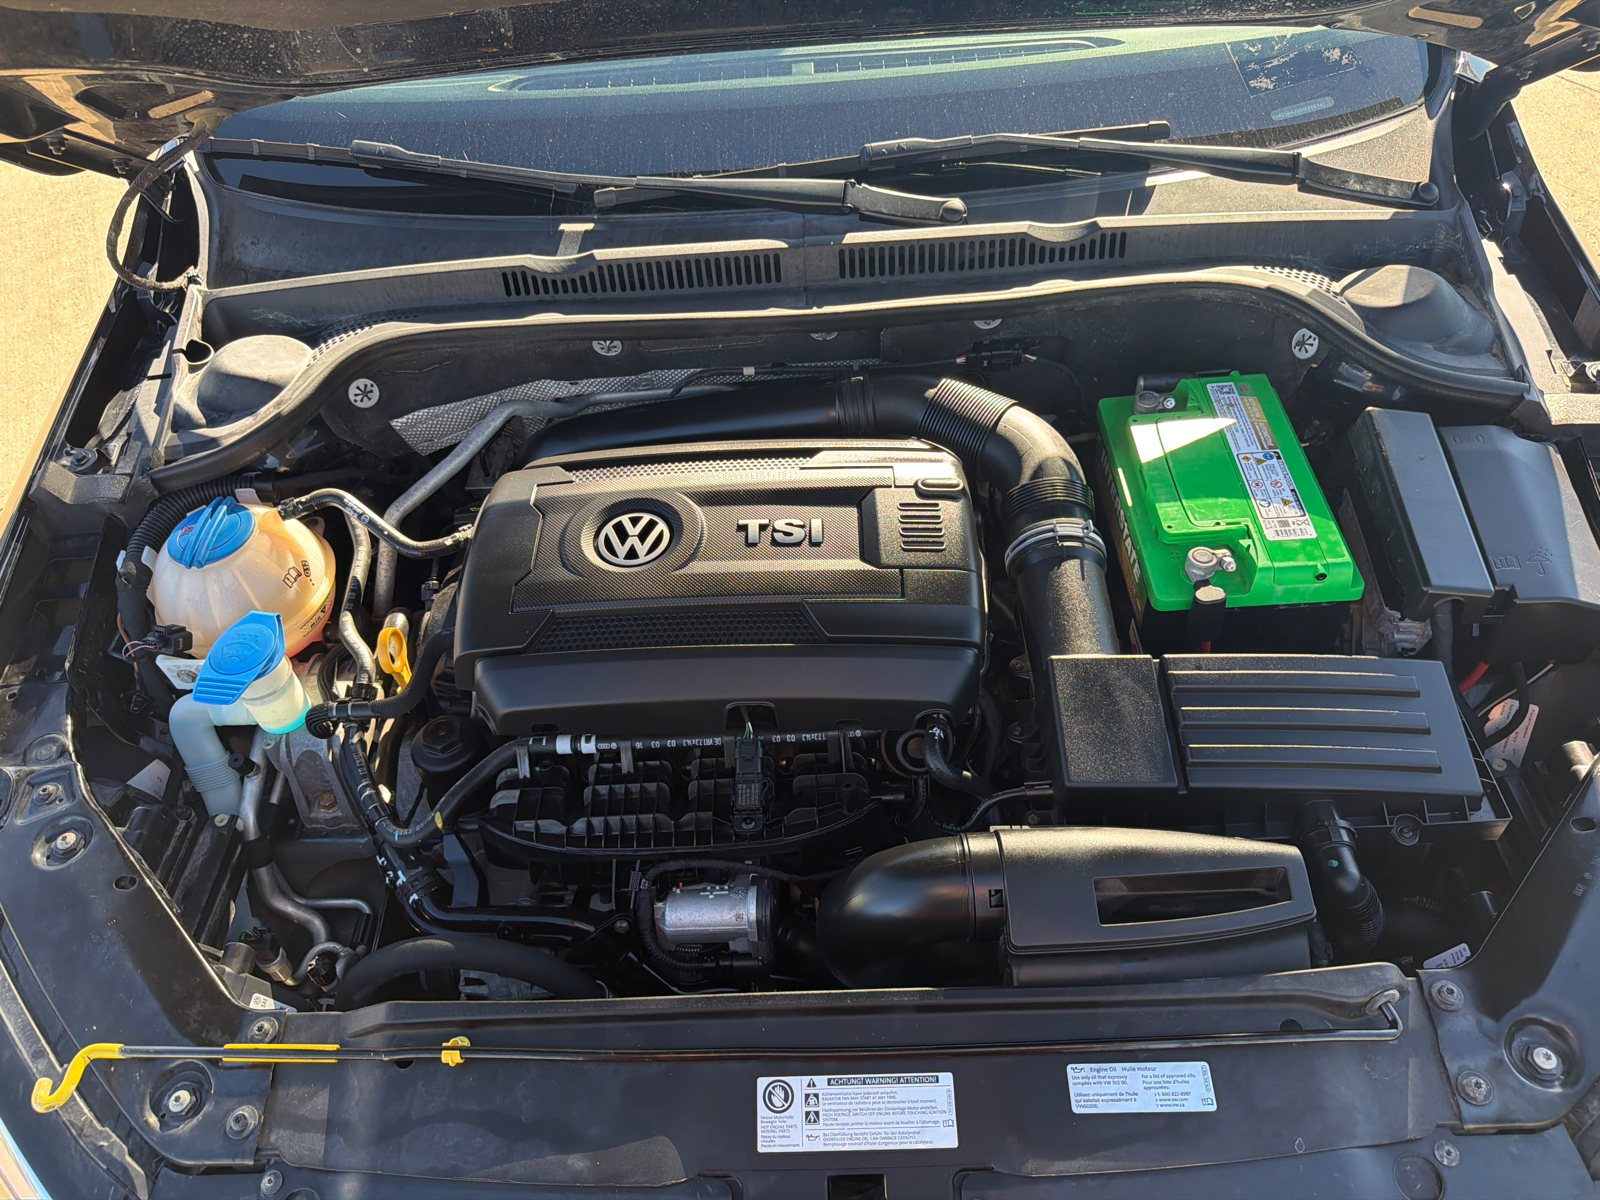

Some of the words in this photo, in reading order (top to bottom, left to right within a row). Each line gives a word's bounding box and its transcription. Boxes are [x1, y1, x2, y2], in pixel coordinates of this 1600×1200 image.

[1101, 448, 1141, 583] INTERSTATE
[738, 518, 823, 544] TSI
[310, 615, 321, 629] min
[771, 734, 781, 743] 03
[786, 734, 796, 742] 03
[651, 740, 660, 749] 03
[667, 739, 676, 748] 03
